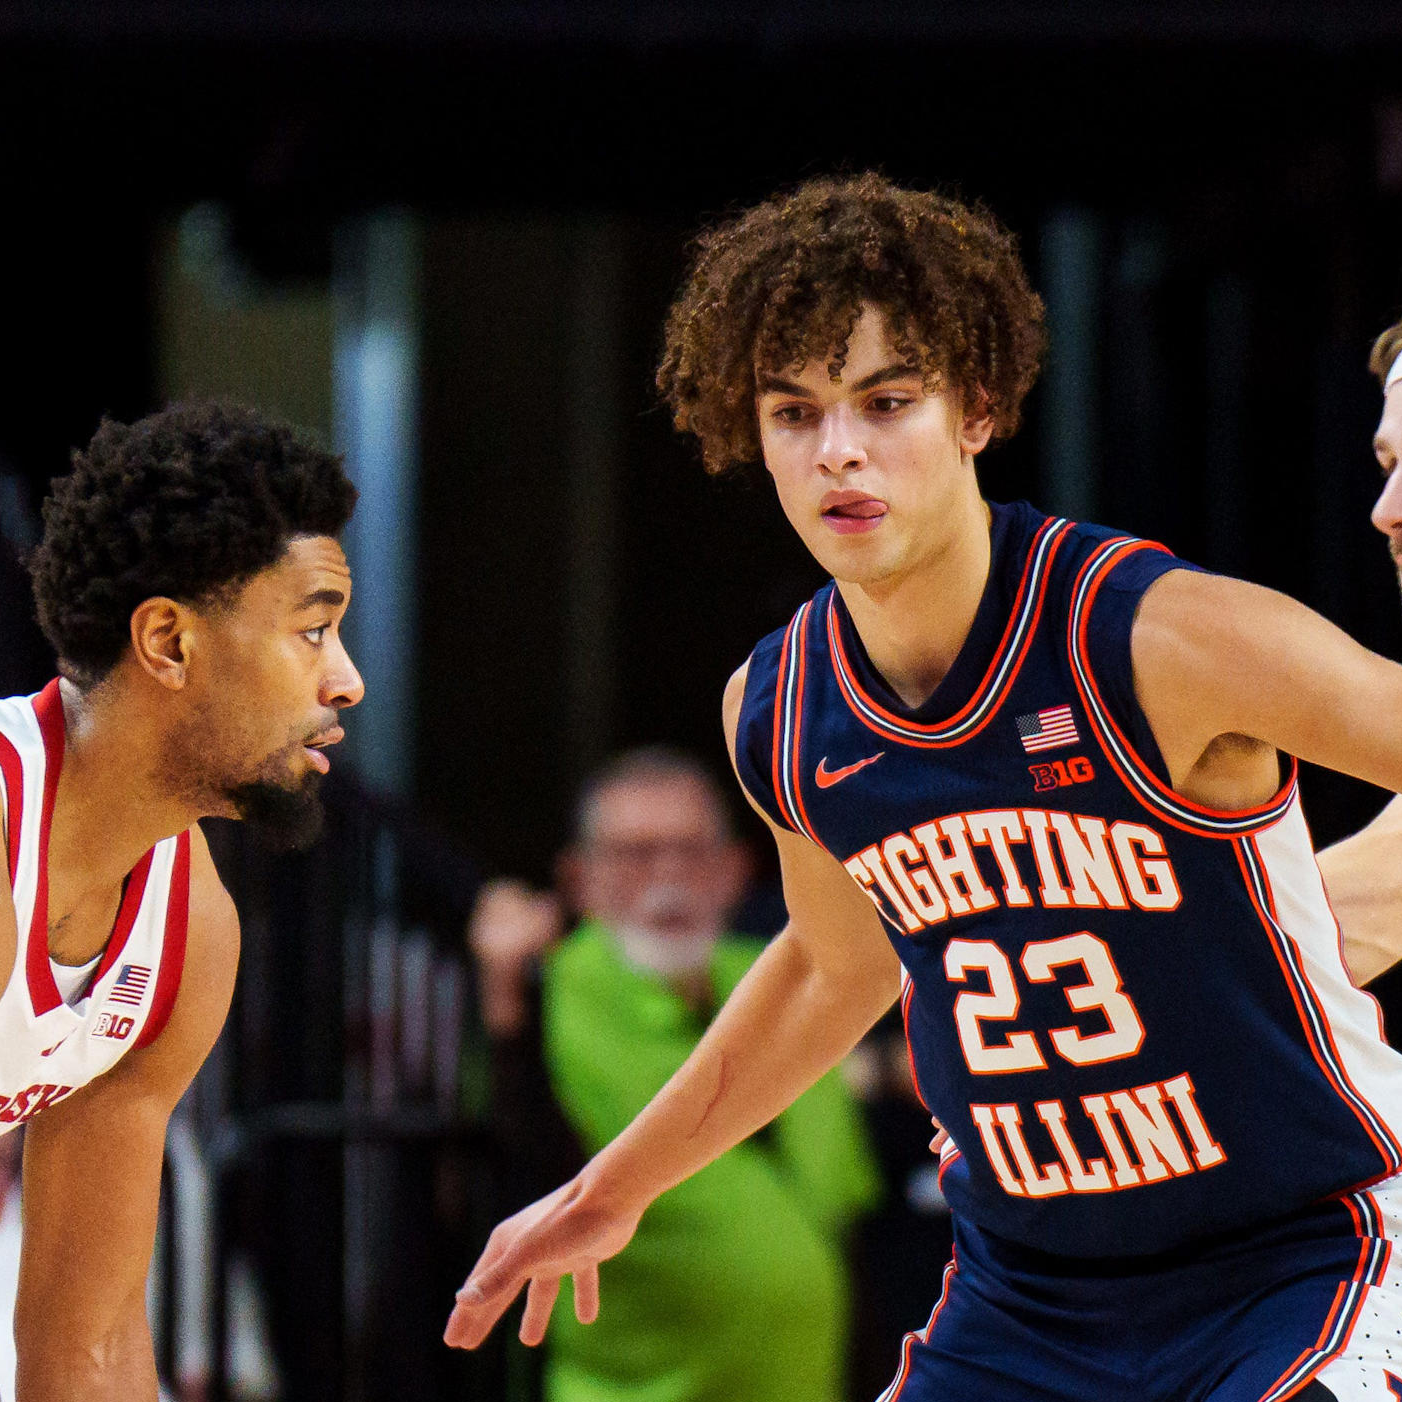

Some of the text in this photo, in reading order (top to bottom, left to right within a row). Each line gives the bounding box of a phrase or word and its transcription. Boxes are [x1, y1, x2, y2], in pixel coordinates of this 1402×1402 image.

[842, 807, 1183, 935] FIGHTING
[943, 930, 1147, 1075] 23
[969, 1071, 1228, 1199] ILLINI
